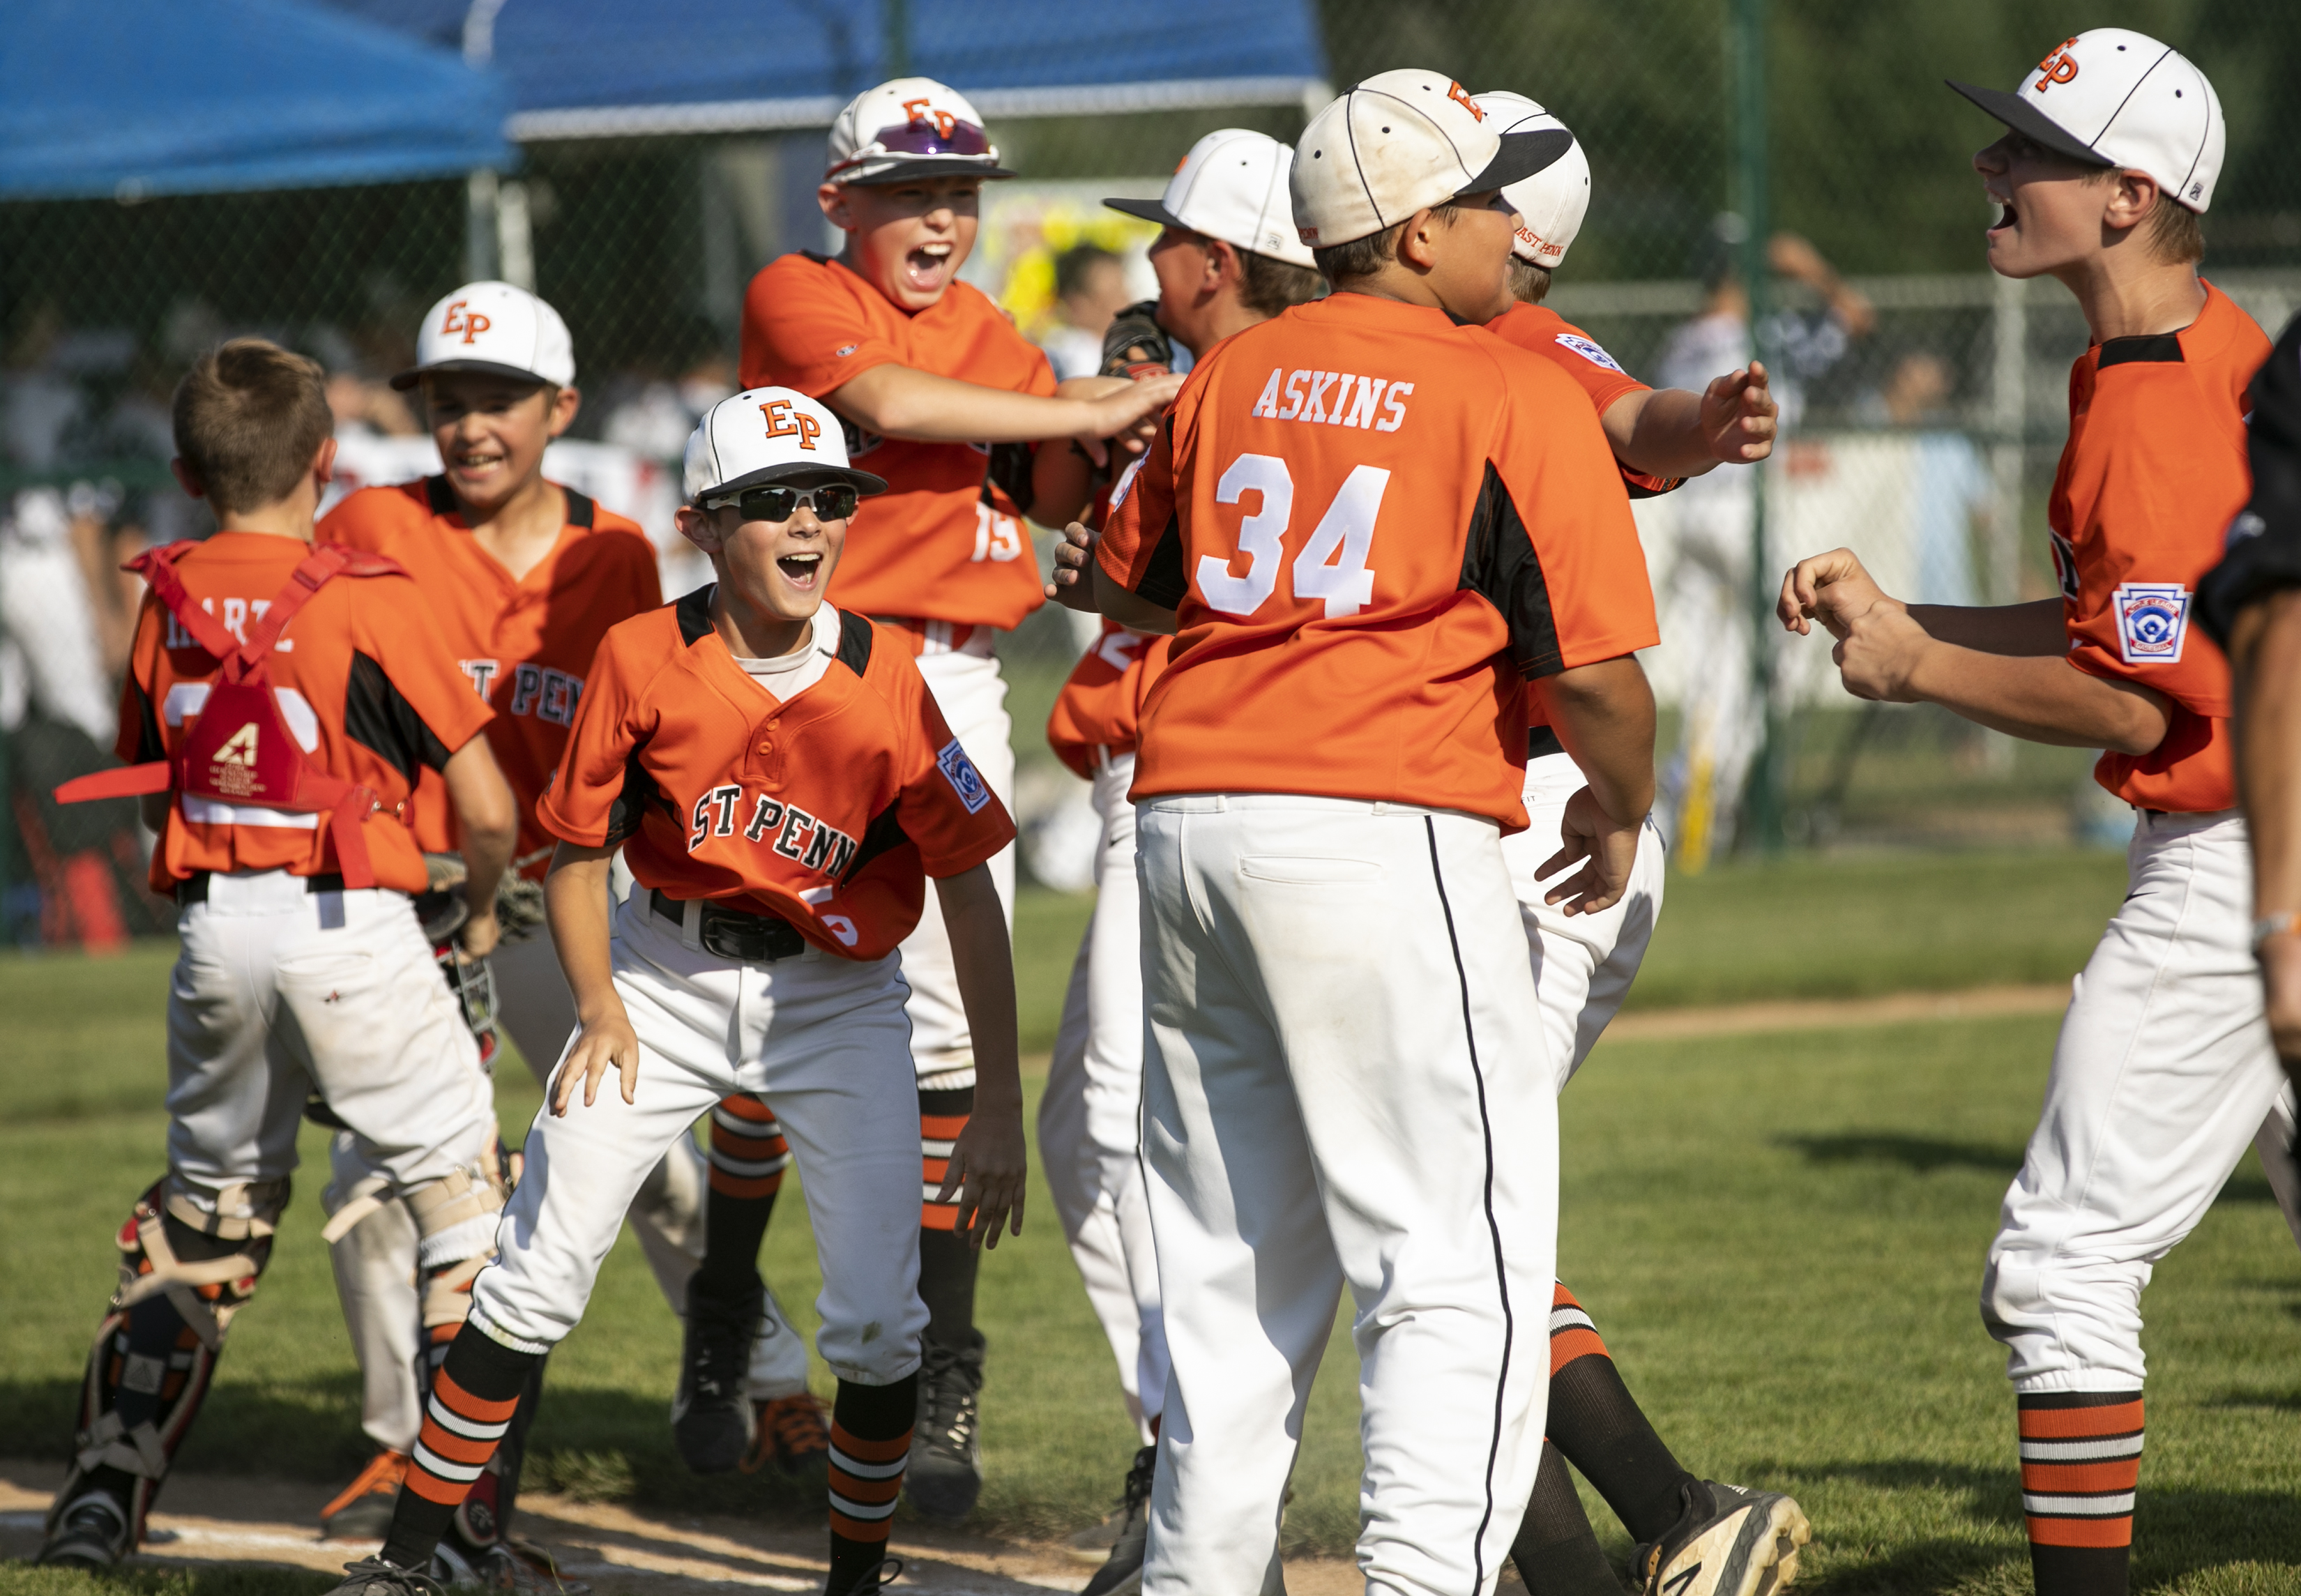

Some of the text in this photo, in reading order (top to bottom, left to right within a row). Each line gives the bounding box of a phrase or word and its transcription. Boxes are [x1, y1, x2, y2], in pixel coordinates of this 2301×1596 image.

[2035, 37, 2079, 93] EP
[1539, 243, 1564, 257] PENN
[440, 301, 491, 344] EP
[1252, 368, 1415, 432] ASKINS
[759, 400, 821, 450] EP
[1196, 453, 1391, 619] 34
[2152, 599, 2178, 614] LEAGUE
[2134, 642, 2172, 651] BASEBALL
[458, 659, 500, 705] T
[743, 793, 858, 879] PENN
